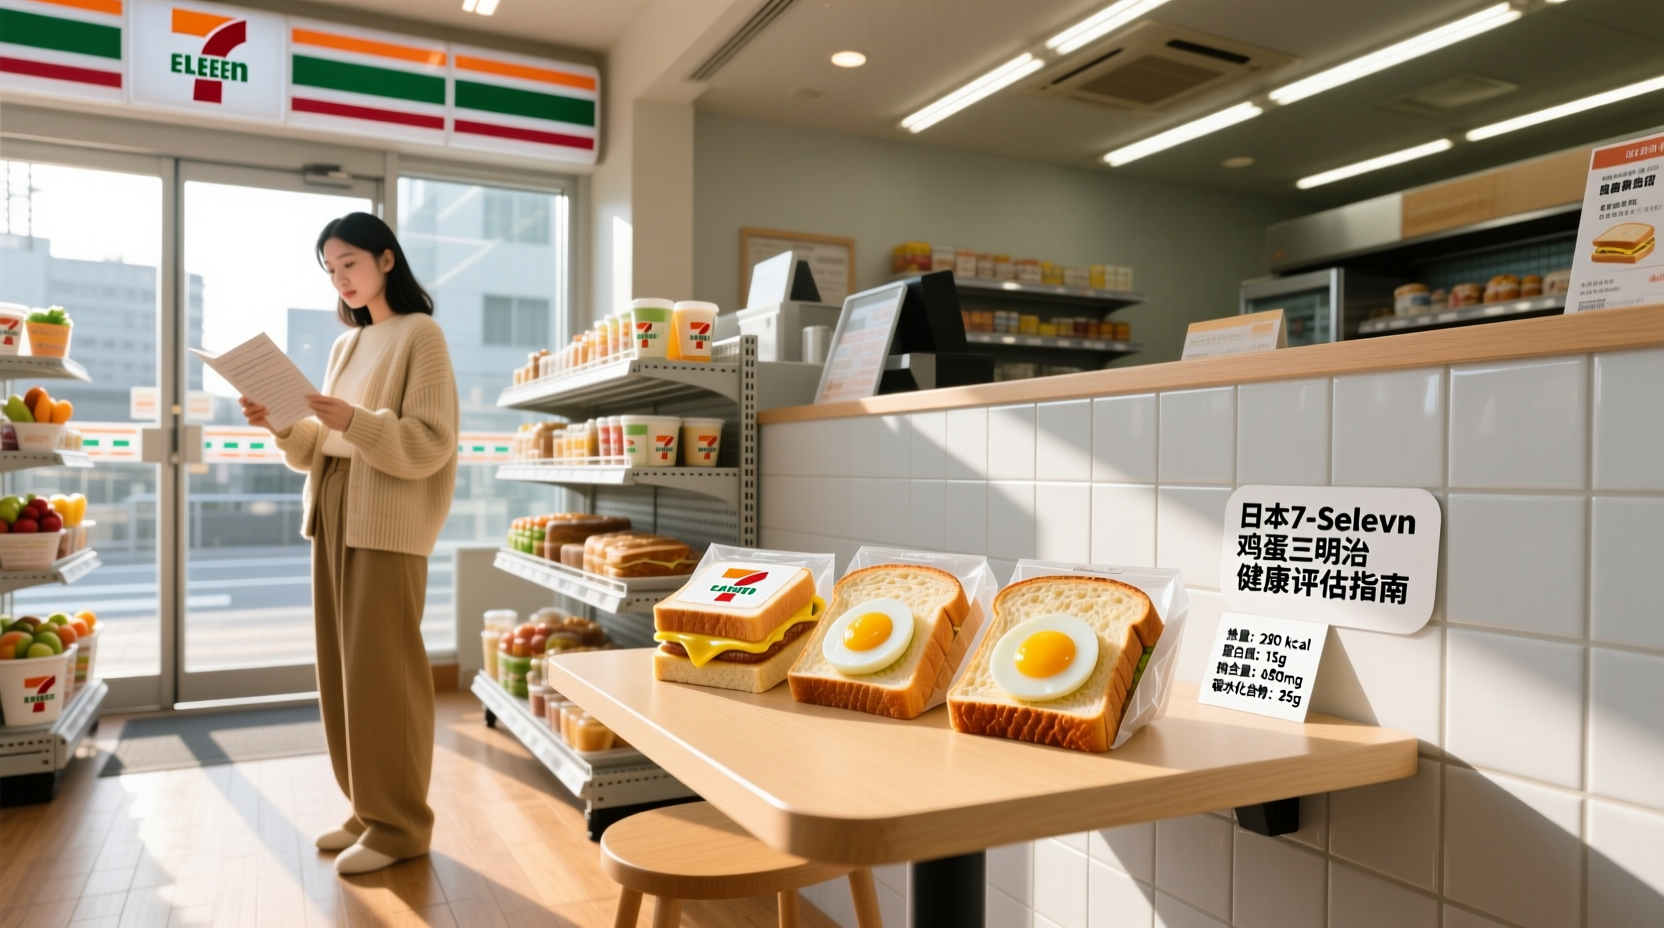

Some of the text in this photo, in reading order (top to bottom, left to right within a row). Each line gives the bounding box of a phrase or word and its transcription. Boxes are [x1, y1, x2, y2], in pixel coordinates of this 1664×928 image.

[1241, 502, 1416, 535] 日本7-Selevn
[1236, 532, 1370, 567] 鸡蛋三明治
[1236, 562, 1410, 605] 健康评估指南
[1284, 635, 1312, 651] kcal
[1266, 651, 1287, 668] 15g
[1278, 689, 1302, 708] 25g
